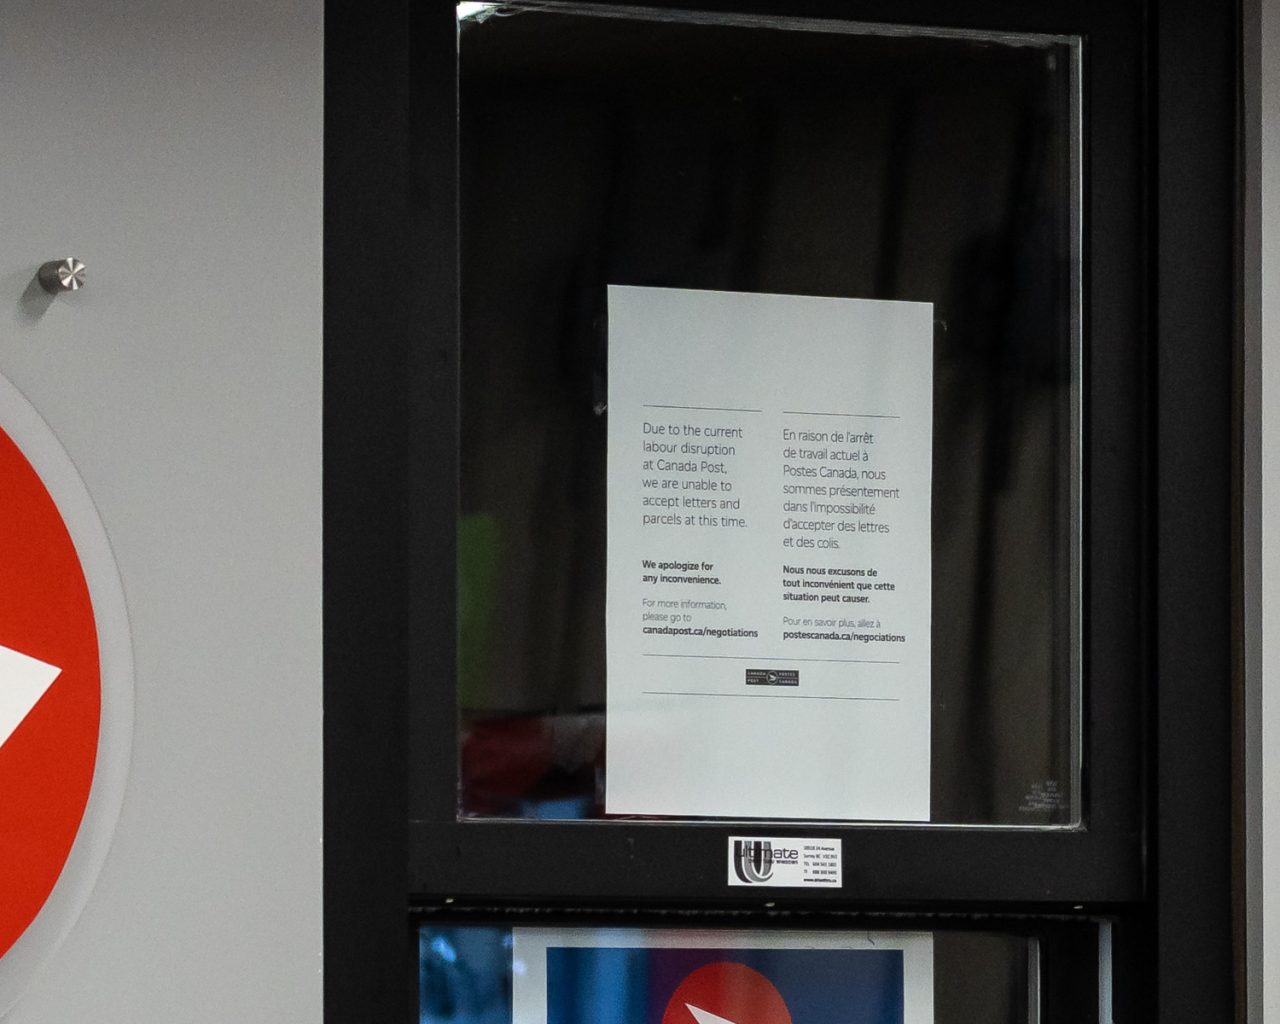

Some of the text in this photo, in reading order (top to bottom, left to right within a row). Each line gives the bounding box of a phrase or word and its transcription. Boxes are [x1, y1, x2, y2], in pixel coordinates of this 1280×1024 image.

[643, 422, 742, 438] Due to the current
[783, 429, 795, 440] En
[799, 432, 828, 441] raison
[831, 432, 844, 442] de
[644, 440, 735, 456] labour disruption
[783, 447, 797, 458] de
[799, 448, 827, 459] travail
[830, 450, 860, 461] actuel
[643, 459, 727, 474] at Canada Post,
[784, 465, 885, 480] Postes Canada, nous
[642, 479, 732, 491] we are unable to
[783, 485, 899, 498] sommes présentement
[643, 496, 740, 509] accept letters and
[783, 500, 807, 512] dans
[643, 513, 747, 527] parcels at this time.
[837, 520, 855, 532] des
[858, 521, 889, 533] lettres
[783, 536, 840, 549] et des colis.
[642, 560, 713, 572] We apologize for
[783, 565, 804, 574] Nous
[867, 568, 877, 577] de
[643, 574, 721, 584] any inconvenience.
[783, 579, 800, 587] tout
[803, 579, 854, 589] inconvénient
[857, 583, 872, 591] que
[643, 598, 655, 607] For
[783, 593, 819, 601] situation
[821, 595, 840, 603] peut
[643, 612, 692, 623] please go to
[783, 616, 801, 625] Pour
[858, 619, 874, 629] allez
[643, 626, 758, 638] canadapost.ca/negotiations
[783, 631, 905, 643] postescanada.ca/negociations
